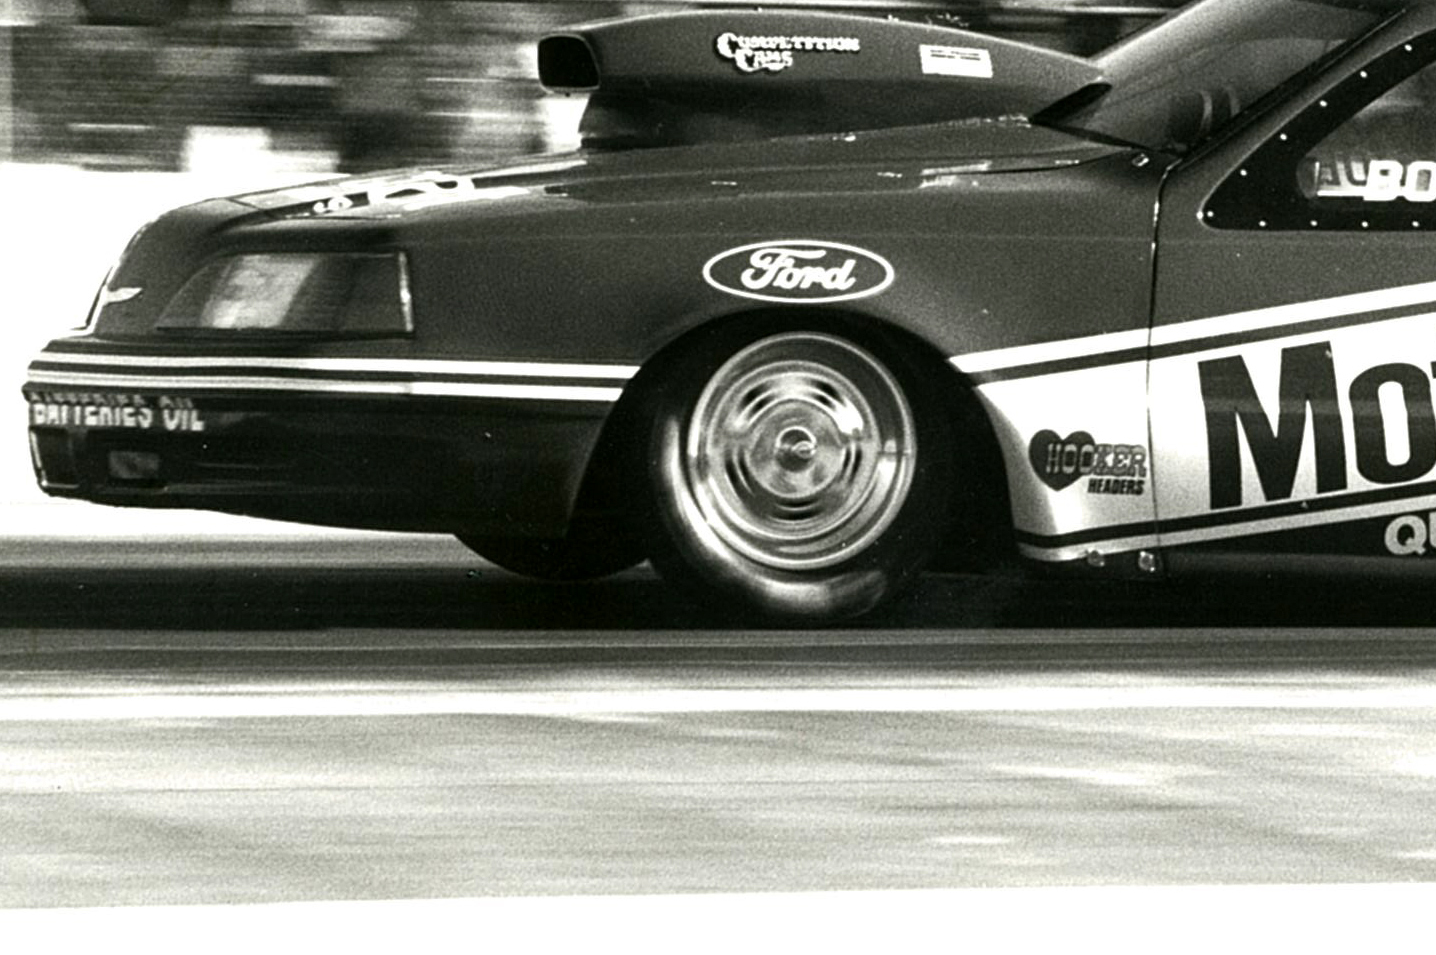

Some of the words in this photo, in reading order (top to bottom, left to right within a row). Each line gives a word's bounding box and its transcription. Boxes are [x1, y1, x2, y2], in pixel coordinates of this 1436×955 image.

[740, 246, 858, 292] Ford
[1046, 443, 1148, 477] HOOKER
[1088, 477, 1145, 496] HEADERS
